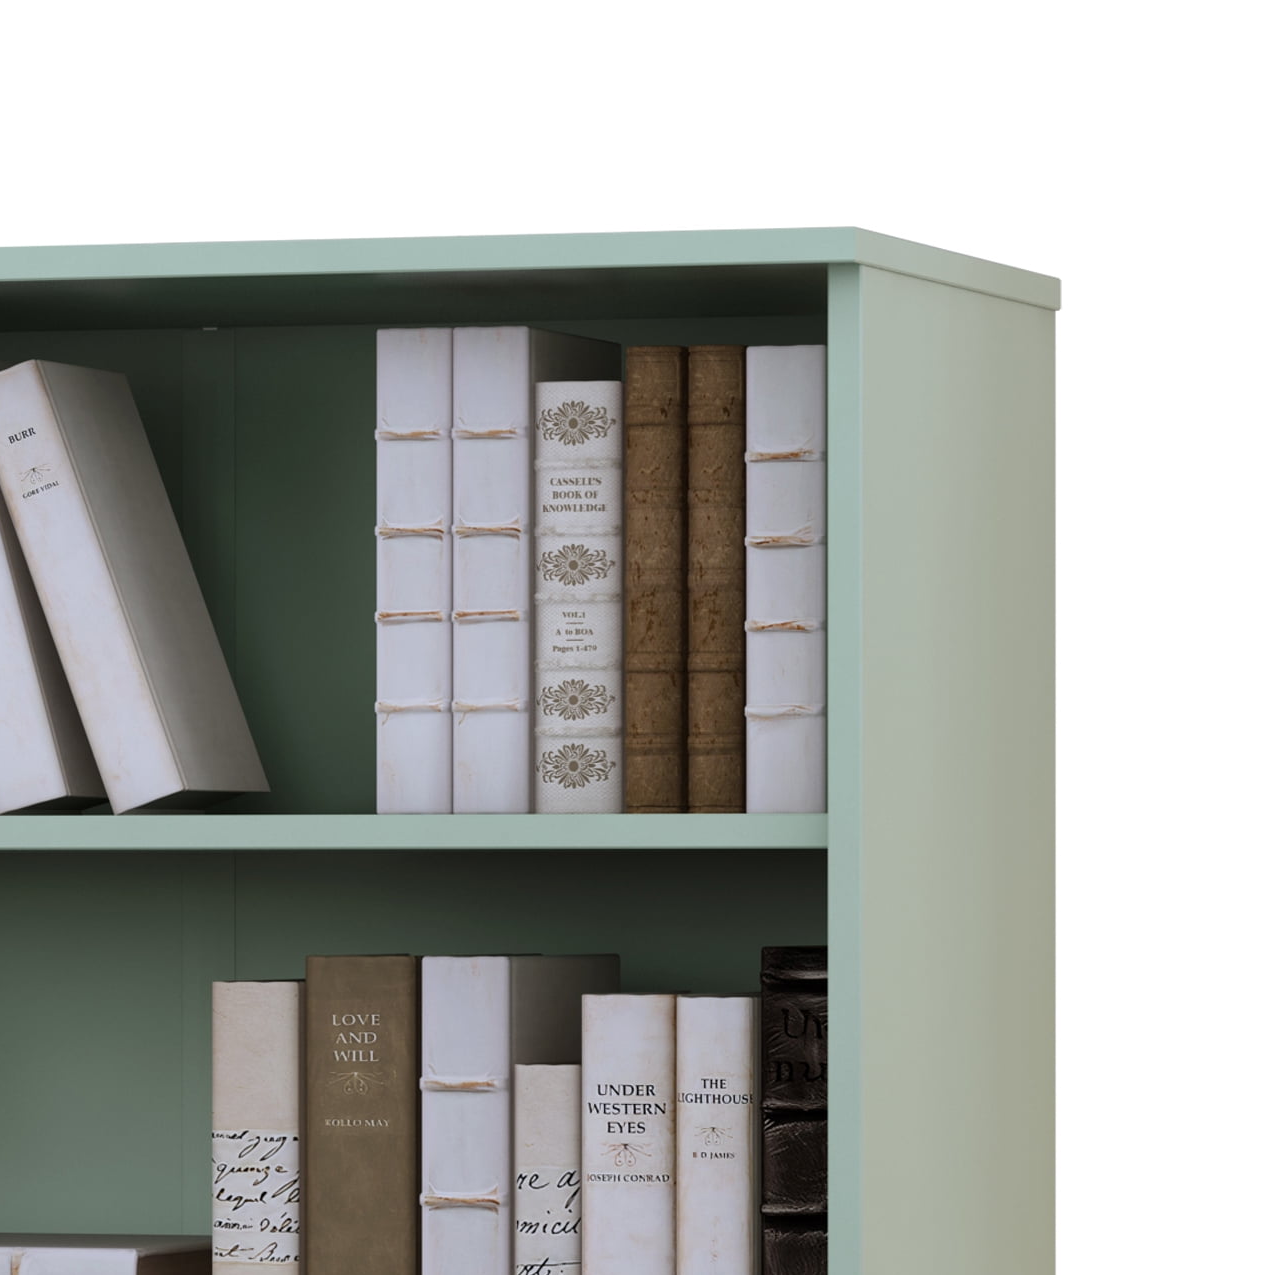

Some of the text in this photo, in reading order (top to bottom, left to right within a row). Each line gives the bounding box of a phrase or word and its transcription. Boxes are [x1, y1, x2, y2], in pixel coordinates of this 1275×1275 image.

[8, 427, 36, 444] BURR
[550, 477, 602, 486] CASSELL'S
[552, 490, 599, 500] BOOK OF
[542, 503, 608, 513] KNOWLEDGE
[574, 628, 594, 636] BOA
[332, 1014, 381, 1026] LOVE
[335, 1031, 377, 1044] AND
[333, 1050, 380, 1062] WILL
[701, 1078, 727, 1090] THE
[597, 1084, 656, 1097] UNDER
[588, 1102, 667, 1115] WESTERN
[325, 1118, 390, 1128] ROLLO MAY
[607, 1121, 646, 1134] EYES
[709, 1151, 736, 1160] JAMES
[623, 1174, 670, 1183] CONRAD
